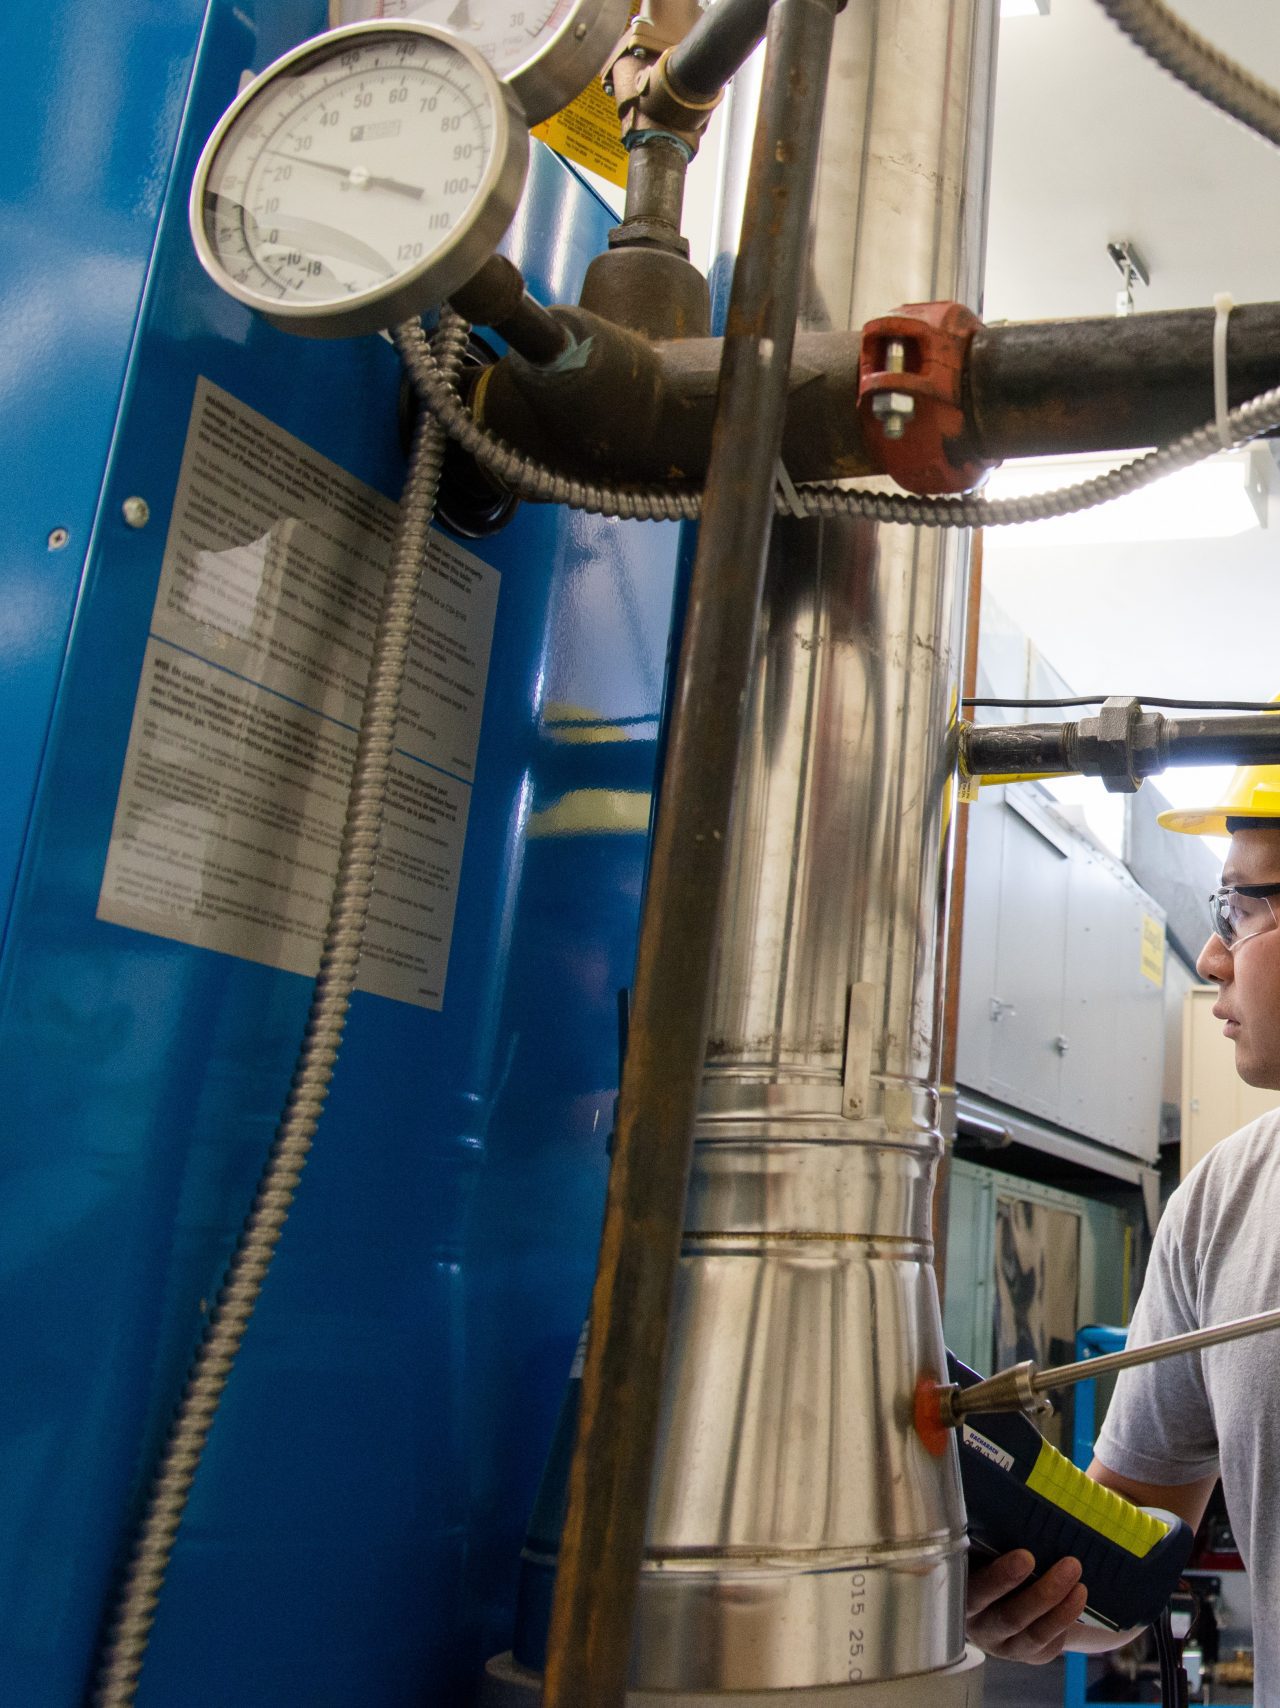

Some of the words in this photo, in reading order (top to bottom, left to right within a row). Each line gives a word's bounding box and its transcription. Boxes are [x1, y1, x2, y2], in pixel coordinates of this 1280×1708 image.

[353, 92, 373, 109] 50
[389, 87, 408, 104] 60
[420, 96, 437, 112] 70
[319, 111, 339, 127] 40
[440, 115, 461, 132] 80
[295, 136, 313, 151] 30
[453, 144, 472, 161] 90
[274, 165, 292, 181] 20
[443, 177, 469, 195] 100
[428, 212, 450, 230] 110
[397, 242, 423, 261] 120
